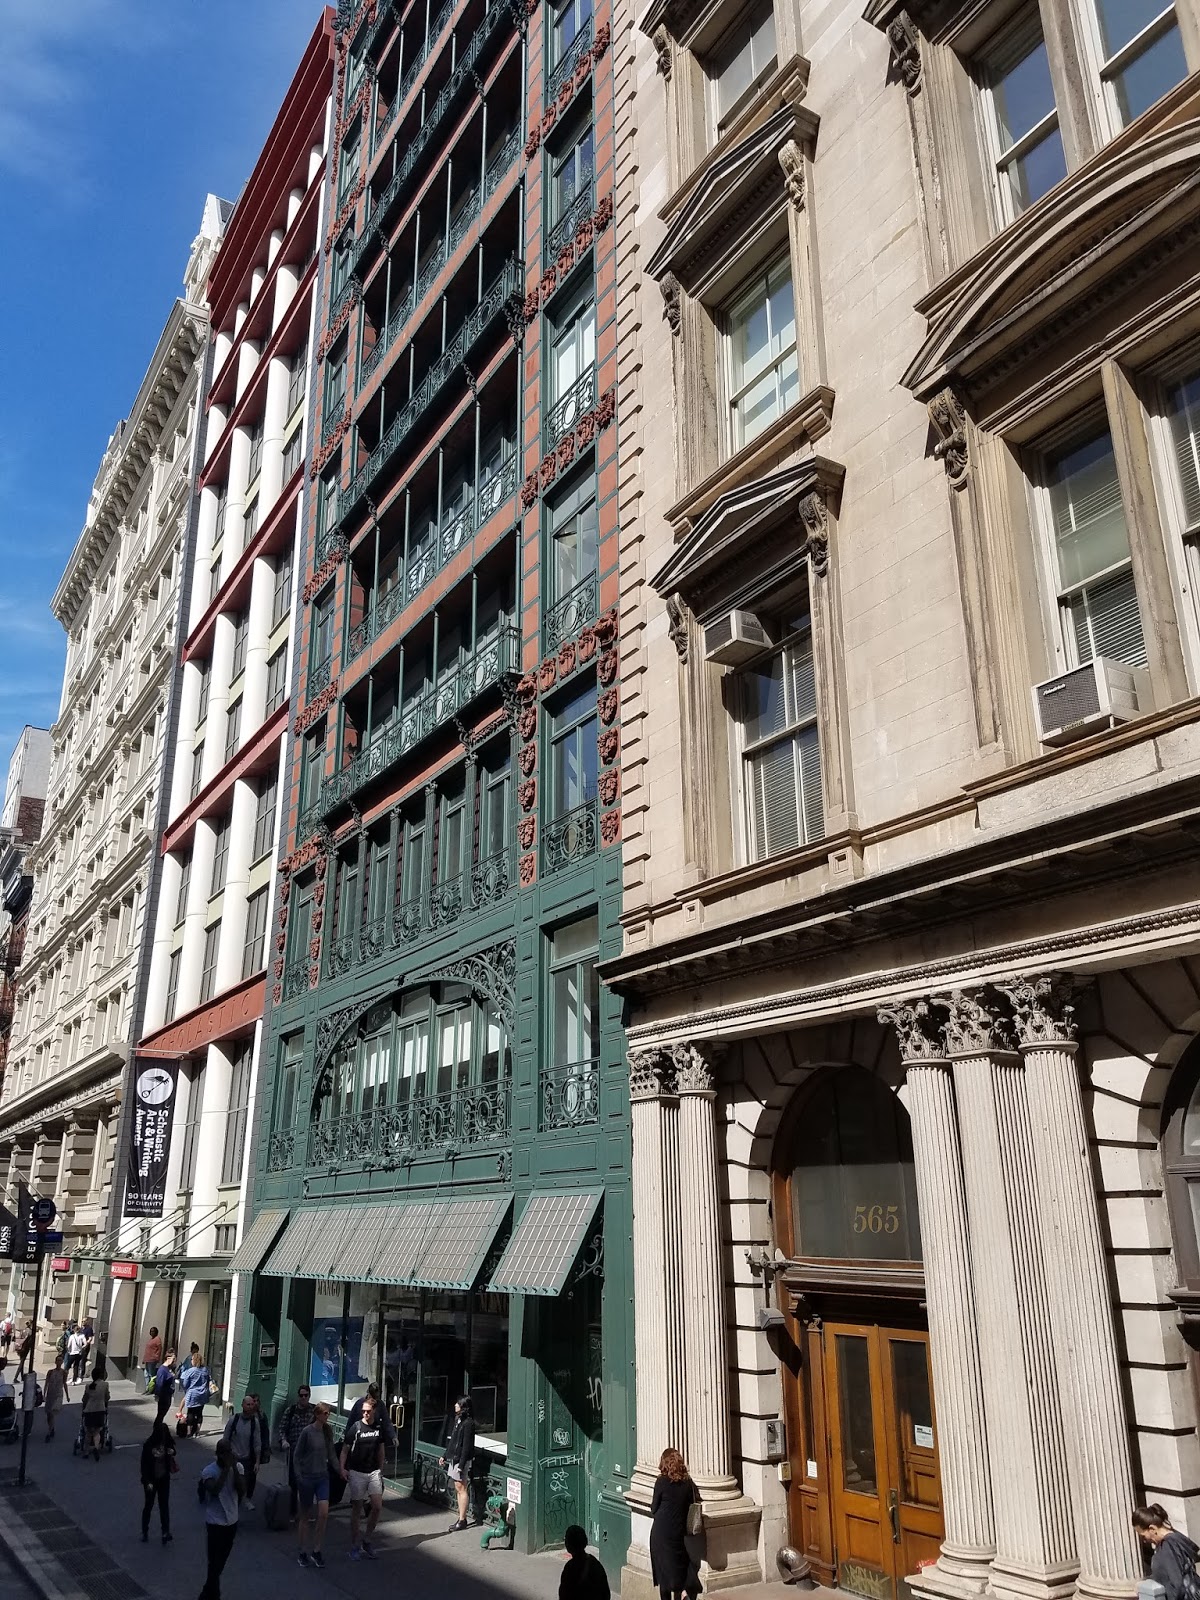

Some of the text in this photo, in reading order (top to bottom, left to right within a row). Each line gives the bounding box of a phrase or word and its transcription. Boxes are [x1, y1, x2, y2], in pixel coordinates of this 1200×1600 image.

[133, 1109, 146, 1147] Awards
[153, 1109, 169, 1163] Scholastic
[138, 1109, 157, 1177] Art & Writing
[127, 1192, 139, 1200] 90
[854, 1205, 899, 1234] 565
[0, 1226, 9, 1253] BOSS
[155, 1263, 182, 1278] 557
